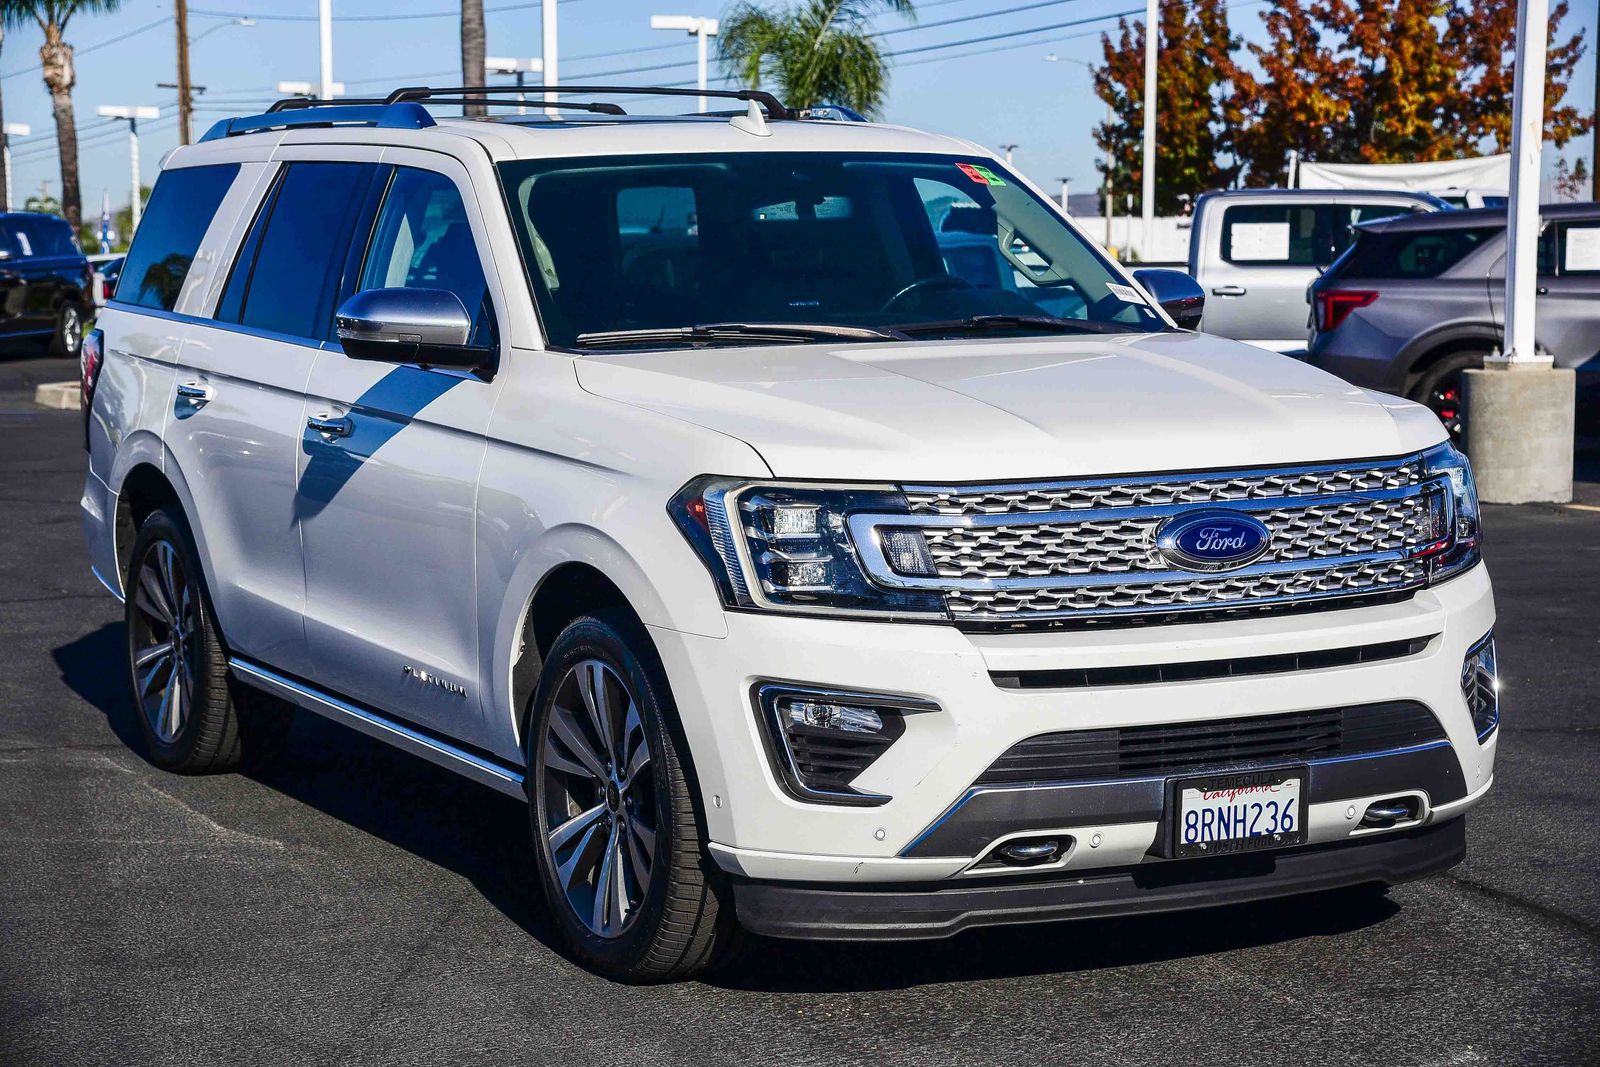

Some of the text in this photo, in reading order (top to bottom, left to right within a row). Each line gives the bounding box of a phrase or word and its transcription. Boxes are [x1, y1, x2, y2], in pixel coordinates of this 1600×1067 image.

[1195, 526, 1247, 551] Ford
[1208, 774, 1276, 789] TEMECULA
[1184, 798, 1295, 844] 8RNH236
